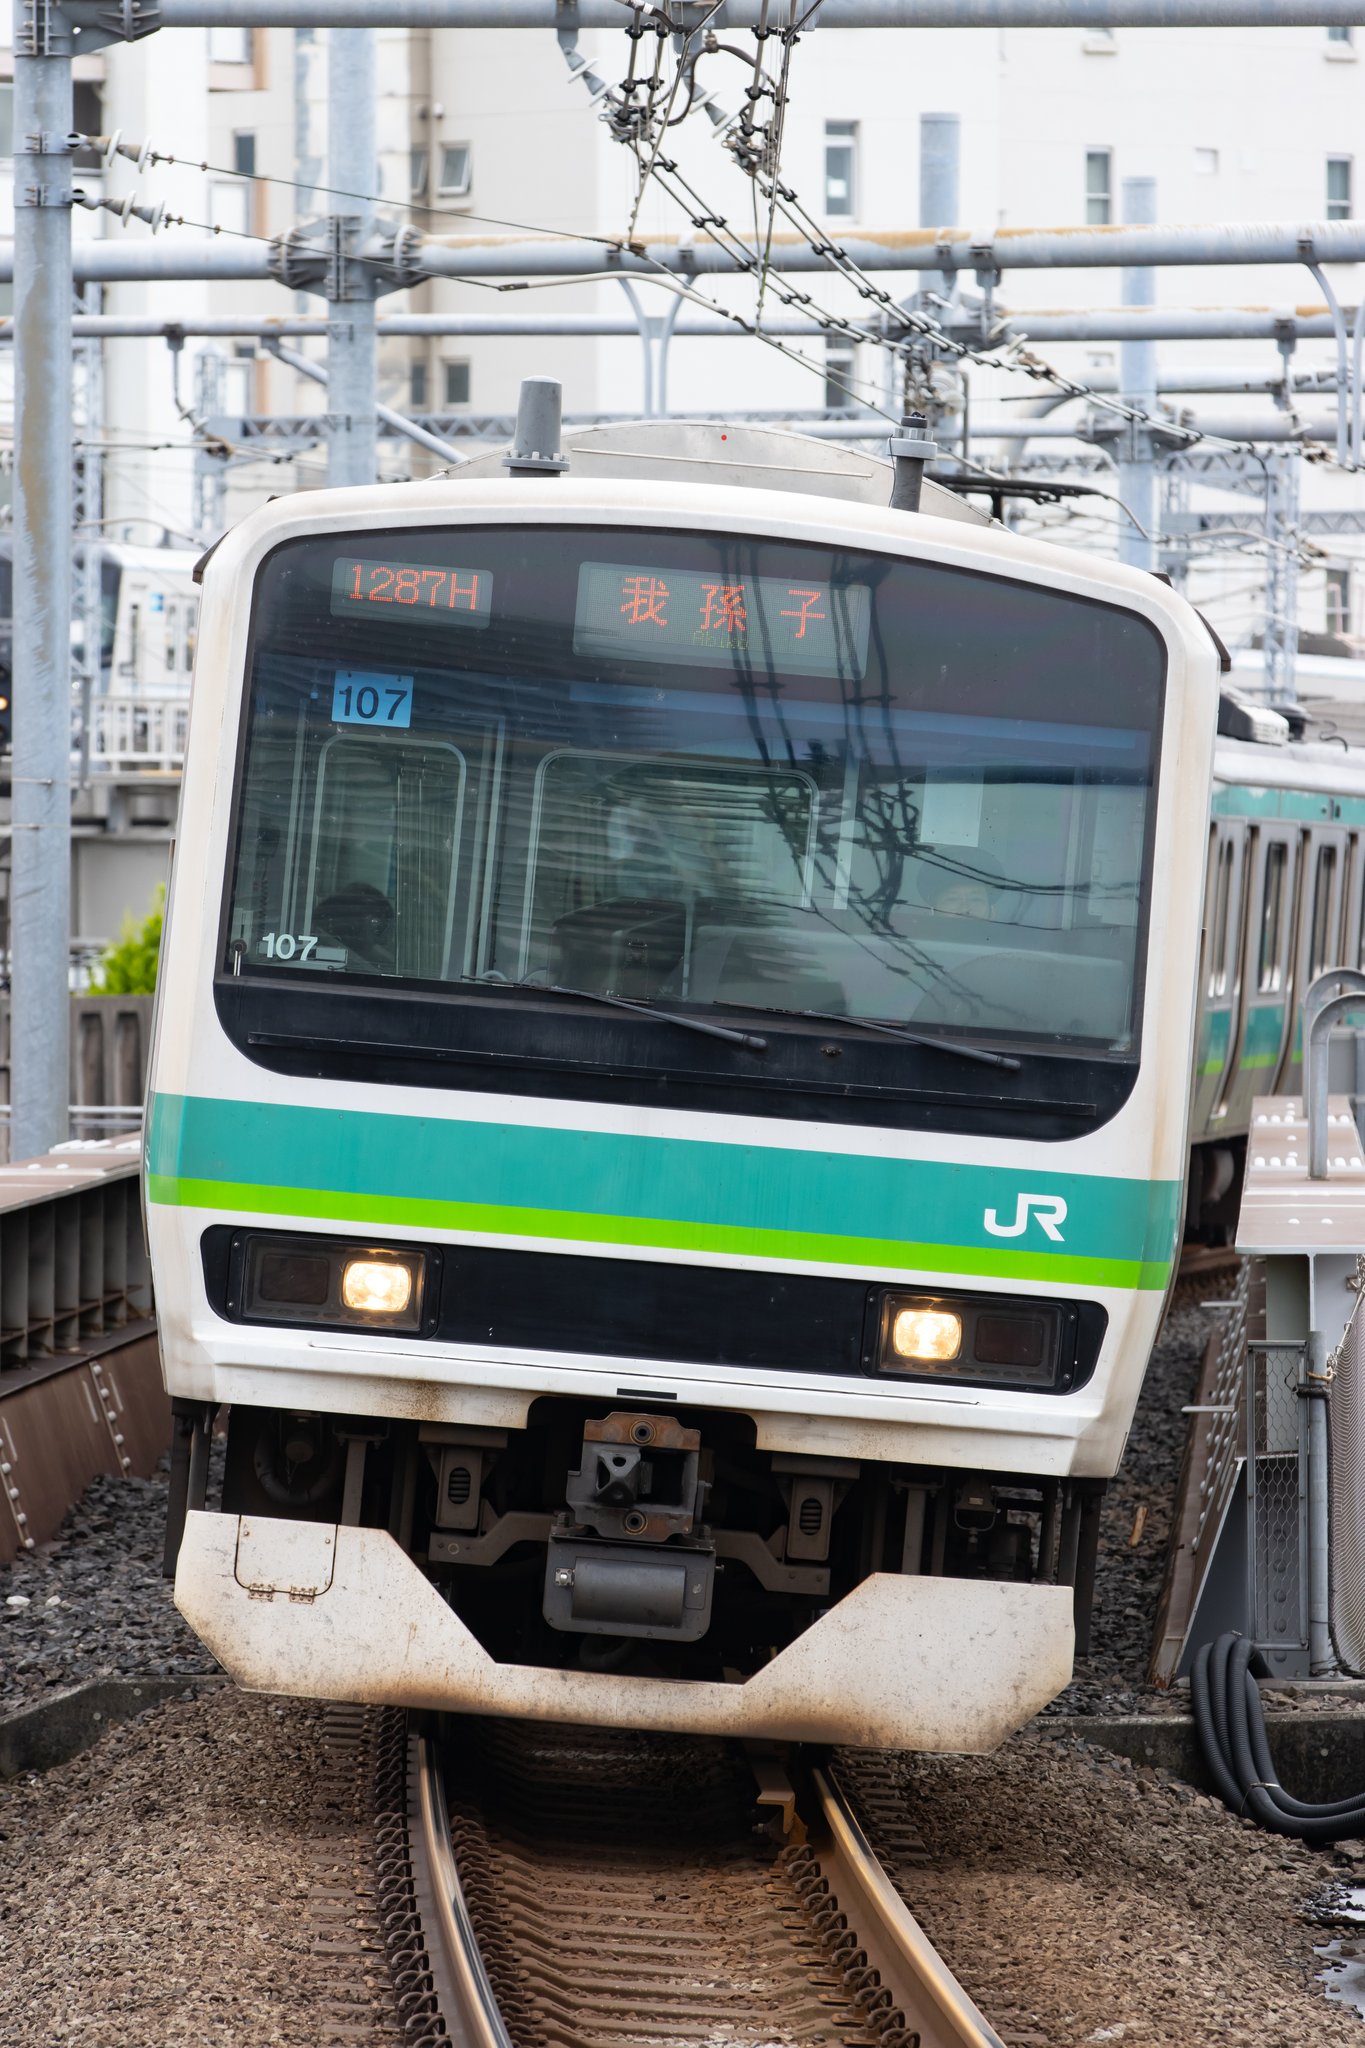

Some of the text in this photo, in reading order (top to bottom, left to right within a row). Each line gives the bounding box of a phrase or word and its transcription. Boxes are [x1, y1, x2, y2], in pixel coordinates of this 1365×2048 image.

[350, 564, 479, 611] 1287H
[620, 576, 826, 638] 我孫子
[338, 685, 408, 721] 107
[262, 932, 318, 961] 107
[983, 1192, 1068, 1242] JR
